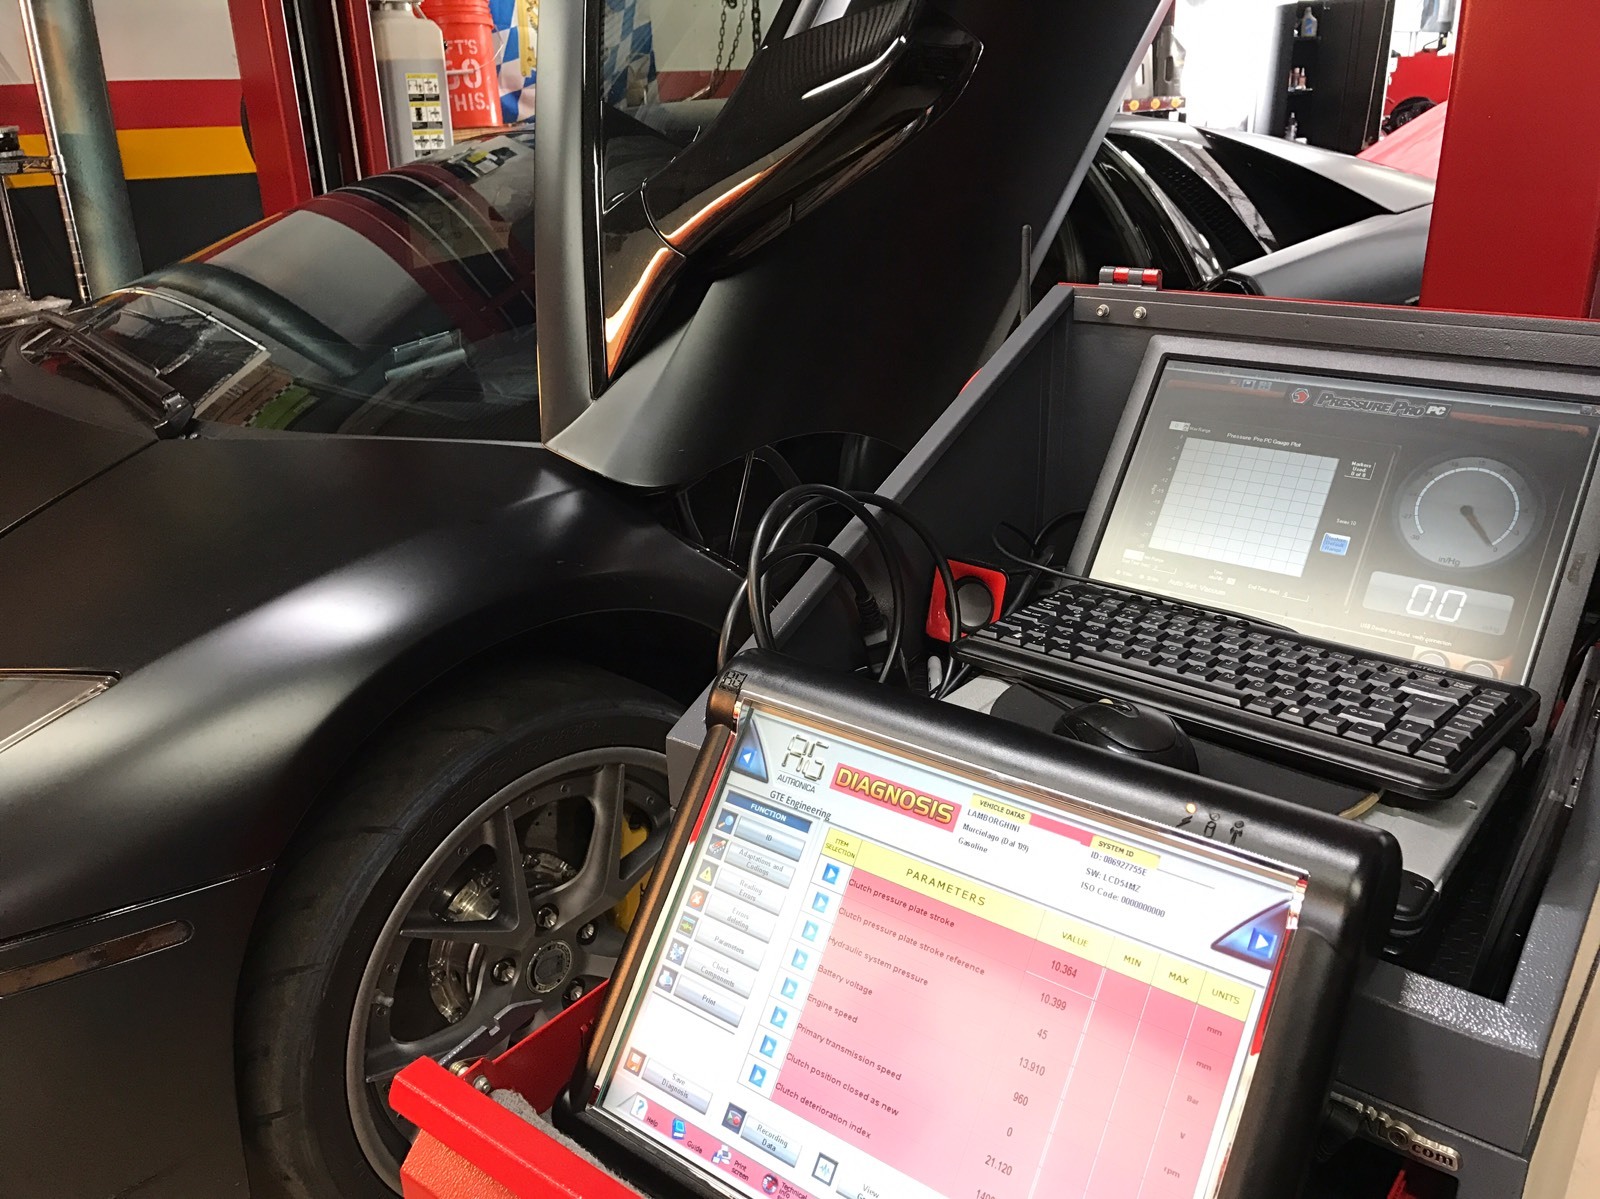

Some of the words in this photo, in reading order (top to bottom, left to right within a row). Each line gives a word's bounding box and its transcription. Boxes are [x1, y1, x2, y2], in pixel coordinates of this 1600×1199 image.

[450, 92, 490, 111] HIS.
[1426, 405, 1447, 416] PC
[1226, 432, 1252, 441] Pressure
[1272, 439, 1290, 447] Gauge
[1438, 555, 1461, 567] in/Hg
[1406, 583, 1467, 623] 0.0
[777, 774, 815, 793] AUTRONICA
[835, 767, 955, 825] DIAGNOSIS
[750, 803, 787, 822] FUNCTION
[770, 790, 786, 804] GTE
[785, 795, 831, 821] Engineering
[979, 800, 1003, 816] VEHICLE
[1004, 807, 1026, 820] DATAS
[967, 809, 1020, 833] LAMBORGHINI
[765, 834, 773, 842] ID
[962, 823, 1000, 842] Murcielago
[825, 843, 855, 859] SELECTION
[835, 838, 849, 848] ITEM
[958, 837, 988, 853] Gasoline
[1098, 841, 1125, 855] SYSTEM
[1126, 849, 1135, 858] ID
[738, 848, 771, 867] Adaptations
[773, 862, 784, 872] and
[1091, 851, 1102, 861] ID:
[745, 861, 769, 877] Codings
[1086, 867, 1101, 879] SW:
[739, 879, 763, 896] Reading
[739, 889, 756, 902] Errors
[1080, 881, 1095, 892] ISO
[1097, 887, 1119, 902] Code:
[732, 907, 749, 920] Errors
[726, 915, 749, 931] deleting
[714, 935, 745, 955] Parameters
[906, 868, 986, 906] PARAMETERS
[1061, 931, 1089, 948] VALUE
[1123, 954, 1142, 968] MIN
[1168, 971, 1190, 985] MAX
[1211, 988, 1240, 1005] UNITS
[848, 878, 872, 894] Clutch
[873, 890, 907, 909] pressure
[908, 903, 928, 918] plate
[929, 912, 955, 928] stroke
[1050, 960, 1078, 979] 10.364
[1206, 1025, 1223, 1037] mm
[712, 961, 729, 974] Check
[700, 966, 735, 988] Components
[838, 907, 862, 923] Clutch
[863, 919, 897, 938] pressure
[898, 933, 918, 947] plate
[919, 942, 944, 958] stroke
[945, 953, 985, 976] reference
[1040, 992, 1067, 1011] 10.399
[1195, 1059, 1212, 1072] mm
[701, 994, 716, 1006] Print
[817, 964, 844, 983] Battery
[845, 978, 873, 996] voltage
[1018, 1057, 1046, 1077] 13.910
[828, 935, 863, 957] Hydraulic
[864, 951, 892, 970] system
[892, 965, 928, 986] pressure
[1037, 1028, 1048, 1041] 45
[1186, 1094, 1200, 1106] Bar
[672, 1073, 686, 1085] Save
[796, 1023, 825, 1043] Primary
[825, 1037, 876, 1068] transmission
[877, 1061, 902, 1081] speed
[1006, 1127, 1013, 1137] 0
[807, 993, 833, 1012] Engine
[834, 1007, 859, 1024] speed
[1012, 1092, 1029, 1107] 960
[1163, 1166, 1181, 1180] rpm
[661, 1078, 689, 1099] Diagnosis
[775, 1082, 799, 1100] Clutch
[800, 1096, 848, 1127] deterioration
[849, 1121, 872, 1139] index
[786, 1052, 810, 1070] Clutch
[810, 1066, 842, 1087] position
[842, 1082, 870, 1101] closed
[870, 1097, 880, 1108] as
[881, 1103, 900, 1117] new
[985, 1155, 1013, 1176] 21.120
[647, 1117, 659, 1128] Help
[756, 1124, 789, 1149] Recording
[761, 1138, 777, 1152] Data
[687, 1140, 703, 1154] Guide
[731, 1166, 750, 1181] screen
[734, 1160, 747, 1172] Print
[781, 1182, 808, 1199] Technical
[862, 1184, 880, 1199] View
